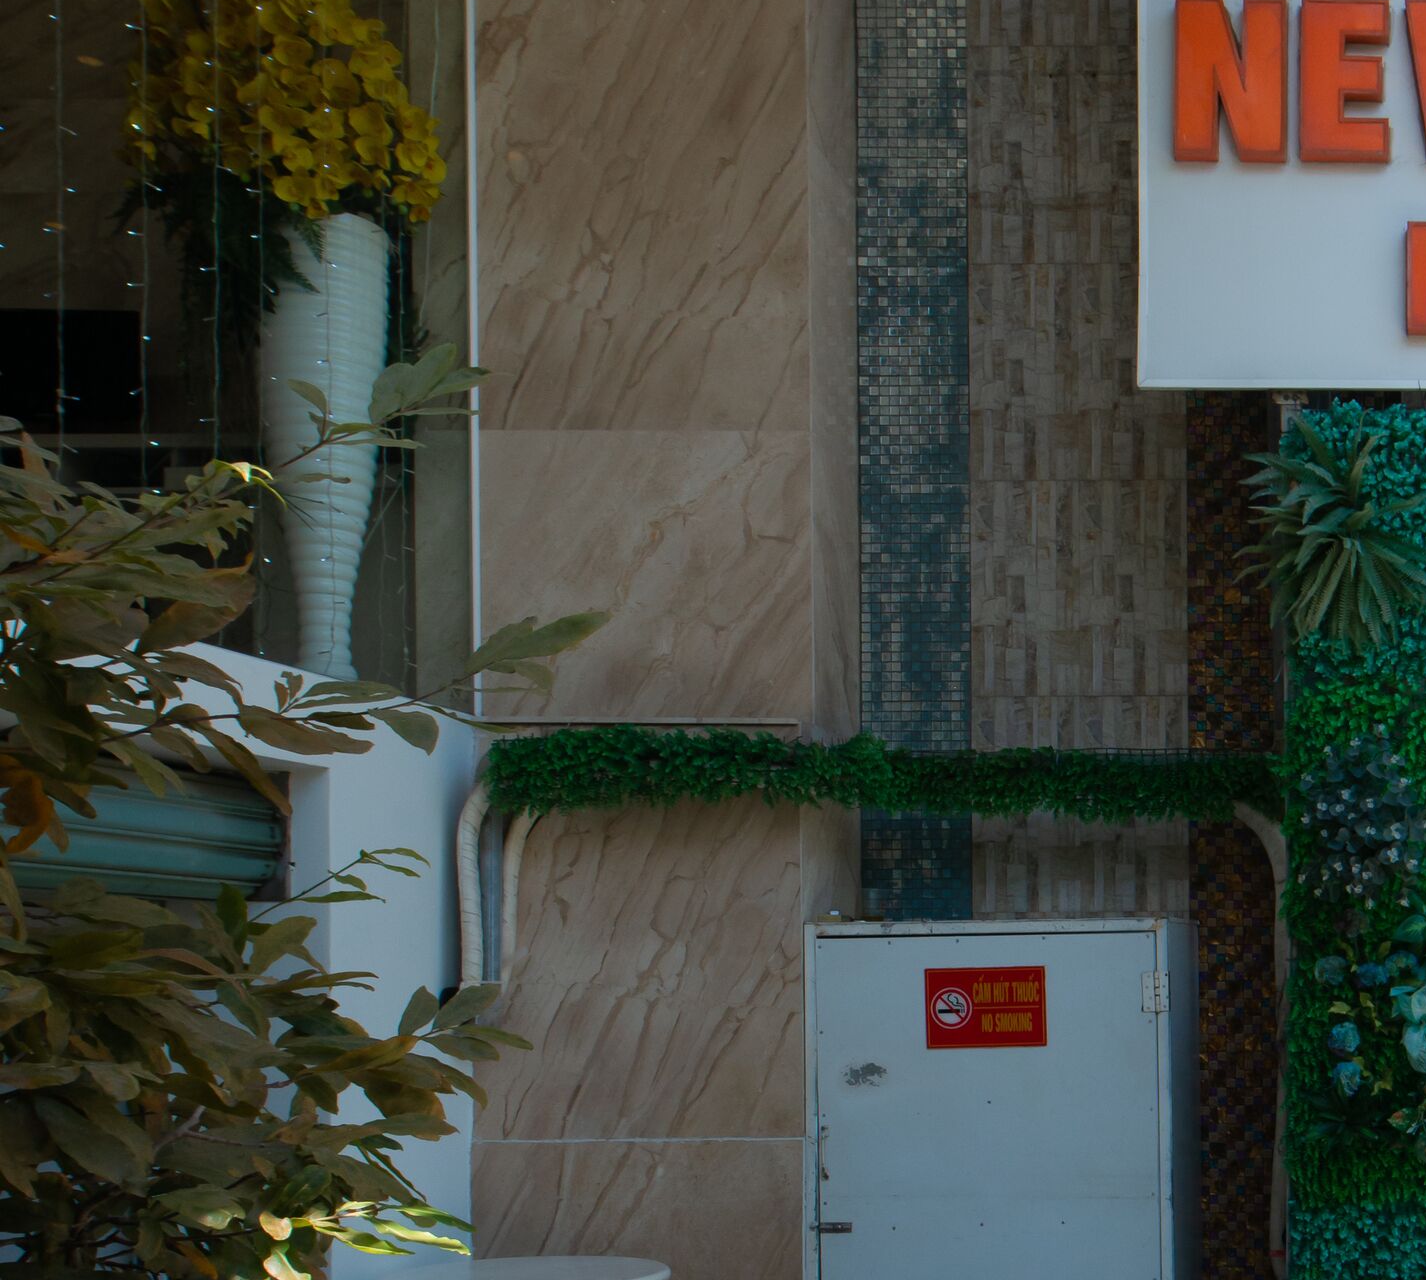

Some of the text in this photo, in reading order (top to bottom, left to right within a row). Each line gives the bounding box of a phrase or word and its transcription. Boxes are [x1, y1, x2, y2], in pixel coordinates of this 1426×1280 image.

[973, 973, 1040, 1003] CẤM HÚT THUỐC
[981, 1012, 1032, 1032] NO SMOKING
